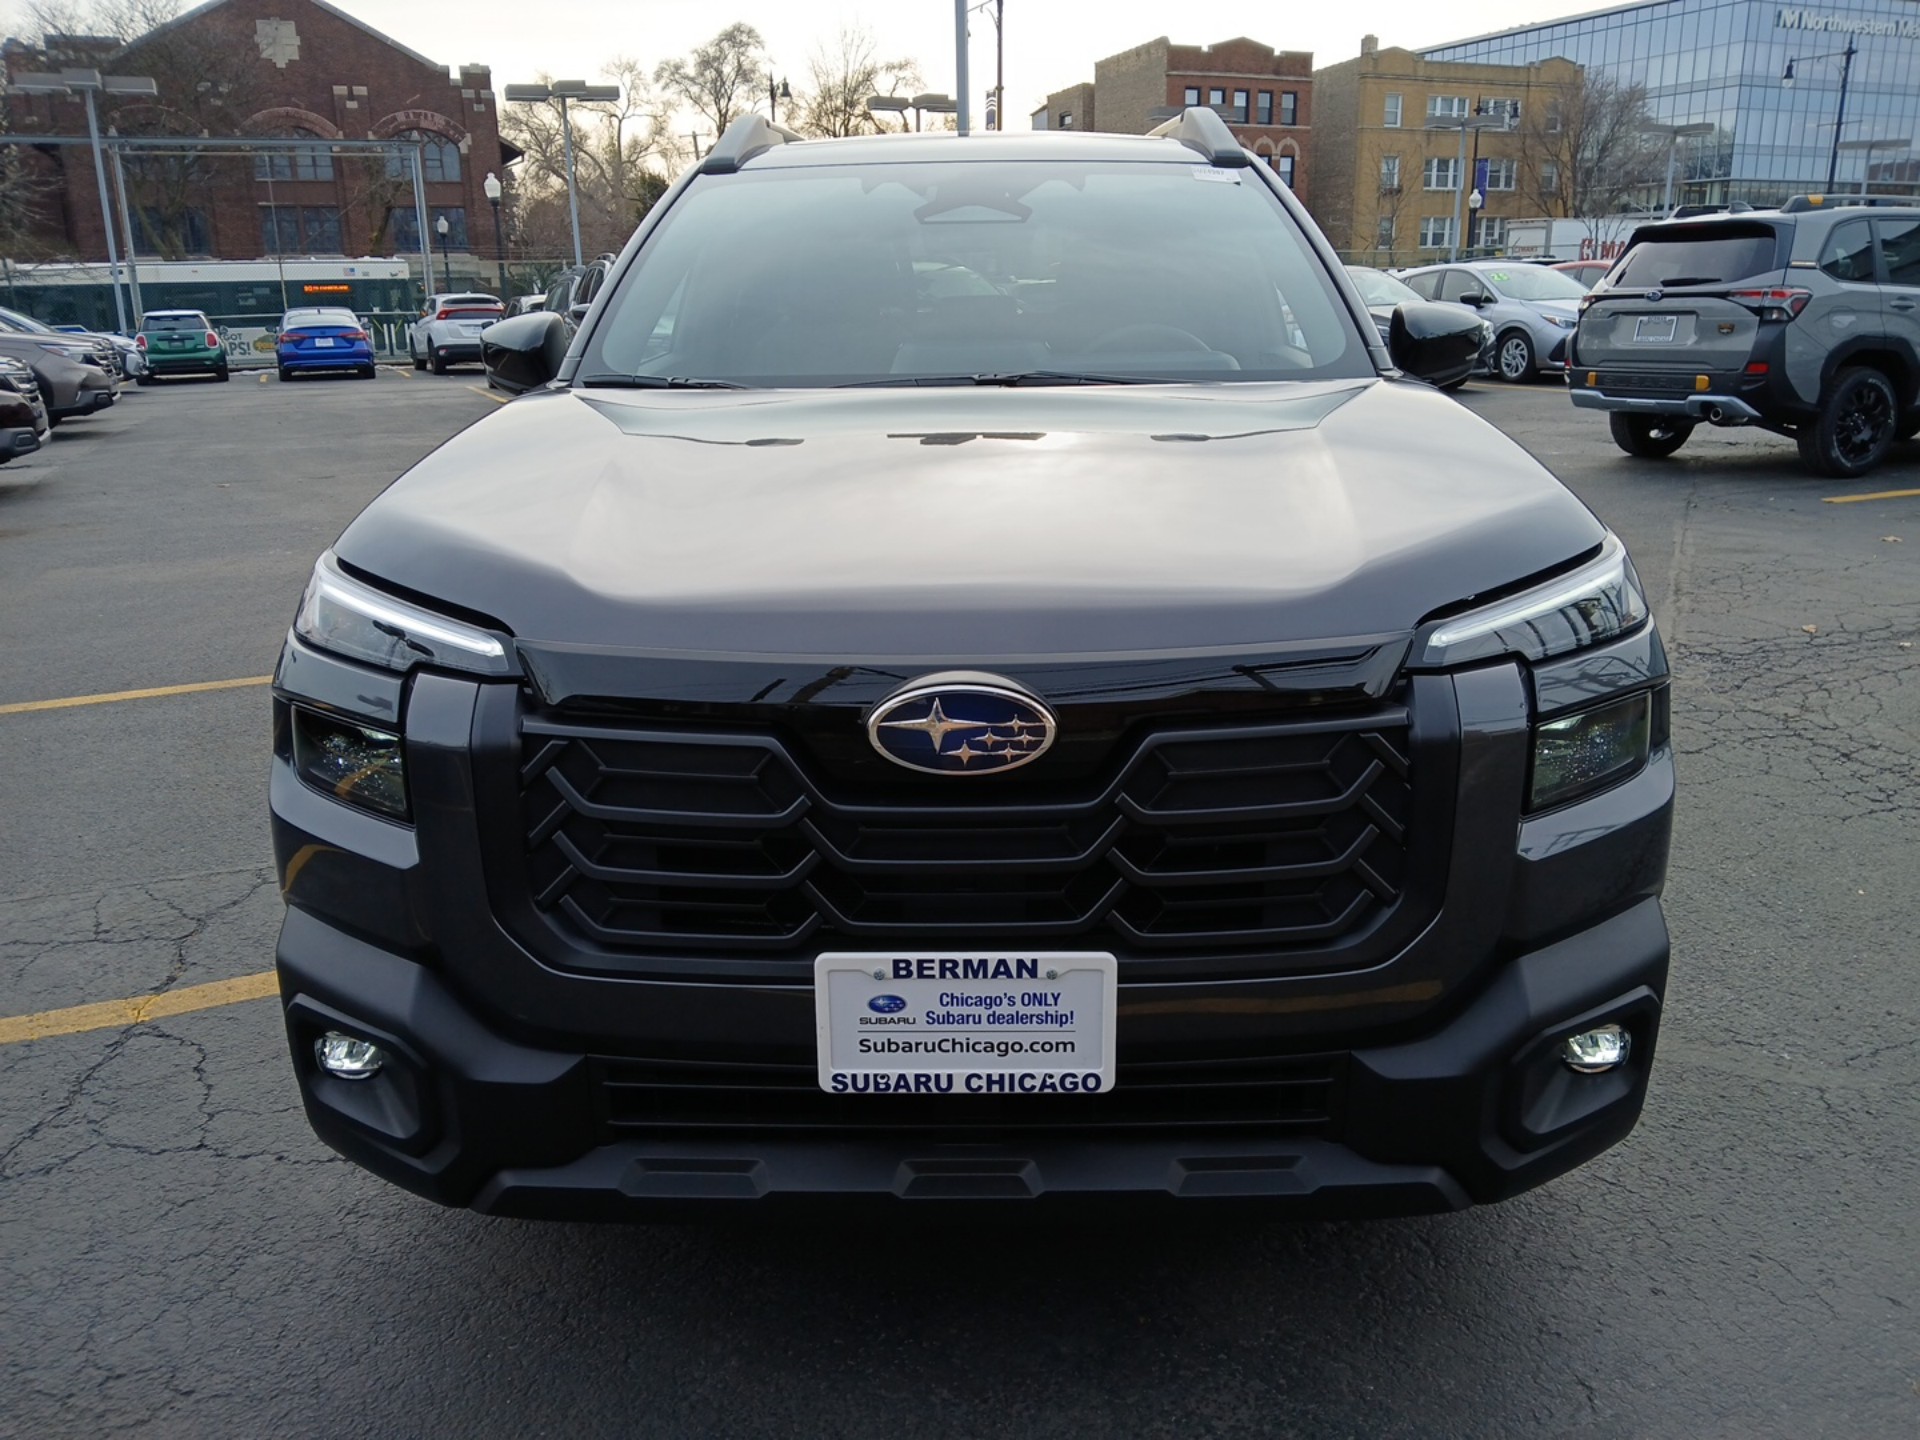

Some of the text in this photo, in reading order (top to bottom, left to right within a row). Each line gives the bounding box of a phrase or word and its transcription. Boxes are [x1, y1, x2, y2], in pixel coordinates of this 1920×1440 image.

[1801, 10, 1897, 36] Northwestern
[892, 958, 1038, 979] BERMAN
[939, 992, 1062, 1010] Chicago's ONLY
[859, 1017, 916, 1025] SUBARU
[925, 1010, 1074, 1028] Subaru dealership!
[859, 1038, 1076, 1057] SubaruChicago.com
[831, 1073, 1102, 1093] SUBARU CHICAGO
